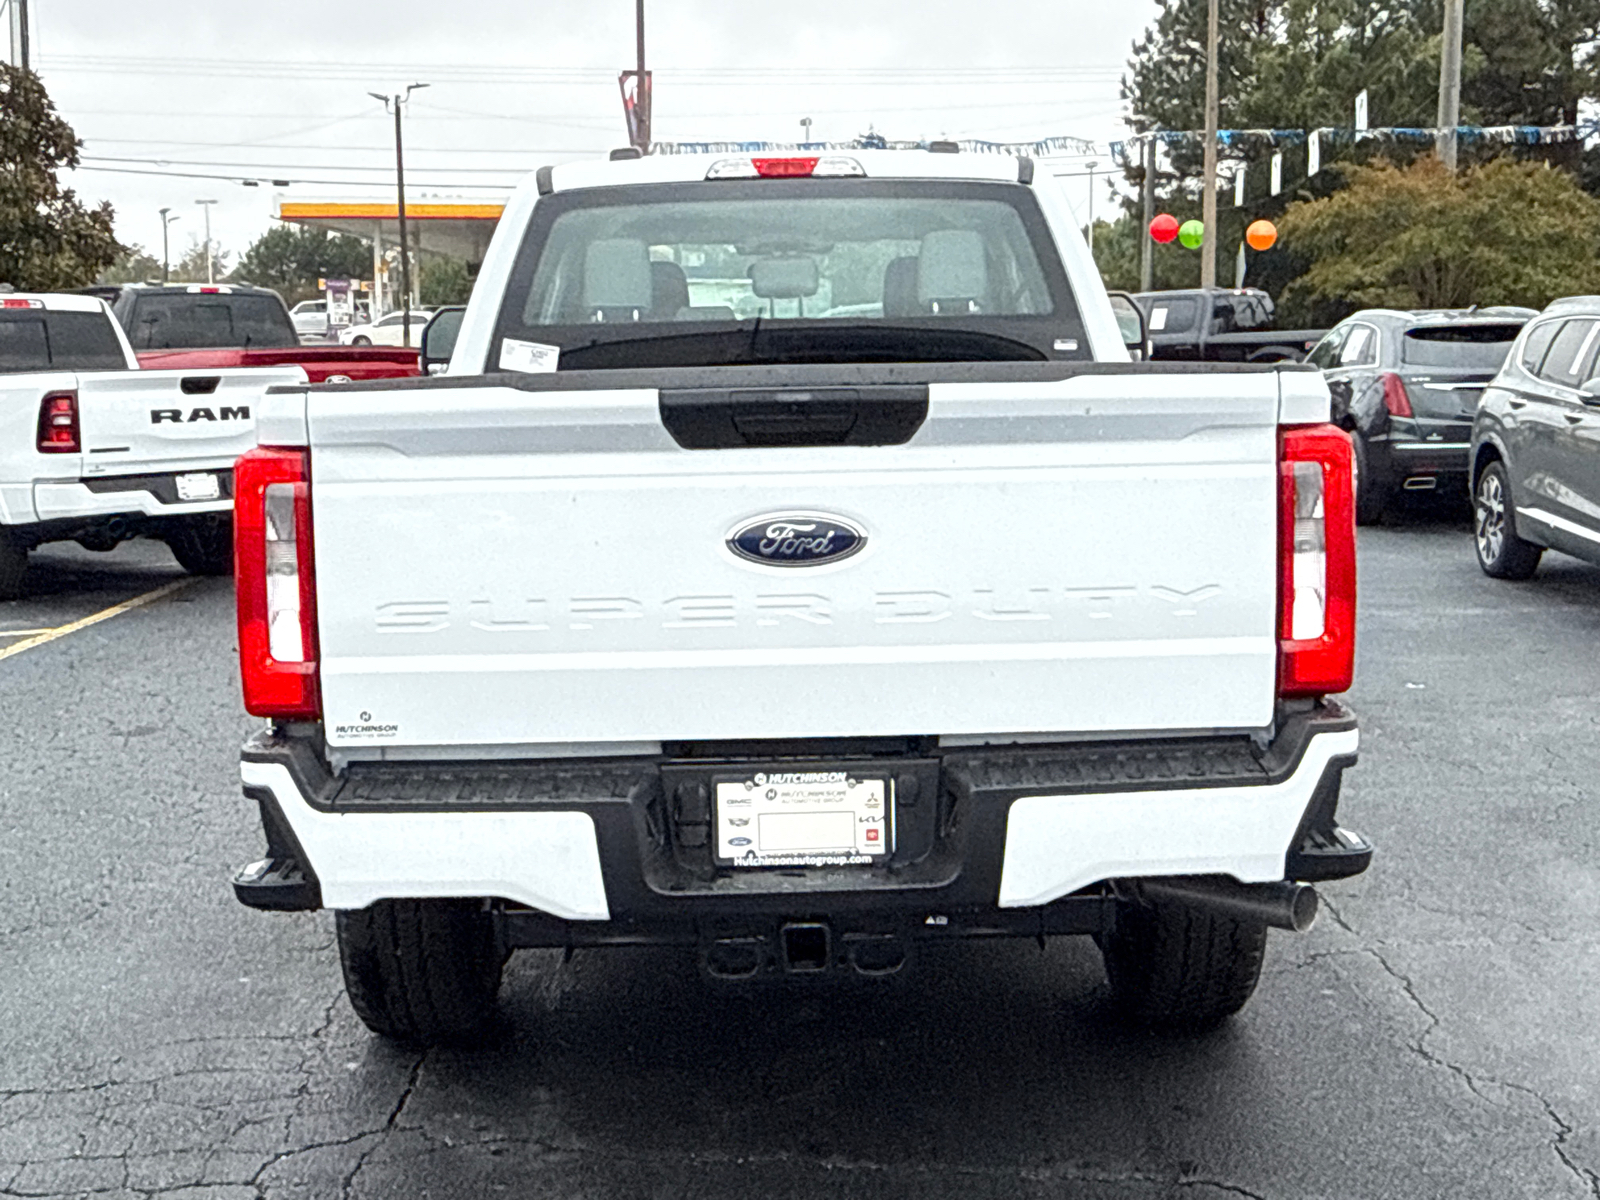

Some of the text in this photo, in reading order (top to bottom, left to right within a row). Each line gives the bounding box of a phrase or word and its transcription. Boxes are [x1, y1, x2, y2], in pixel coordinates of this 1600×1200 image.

[150, 406, 250, 424] RAM
[759, 523, 835, 555] Ford
[375, 584, 1222, 633] SUPER DUTY
[335, 725, 398, 733] HUTCHINSON
[769, 772, 847, 784] HUTCHINSON
[733, 855, 873, 867] Hutchinsonautogroup.com
